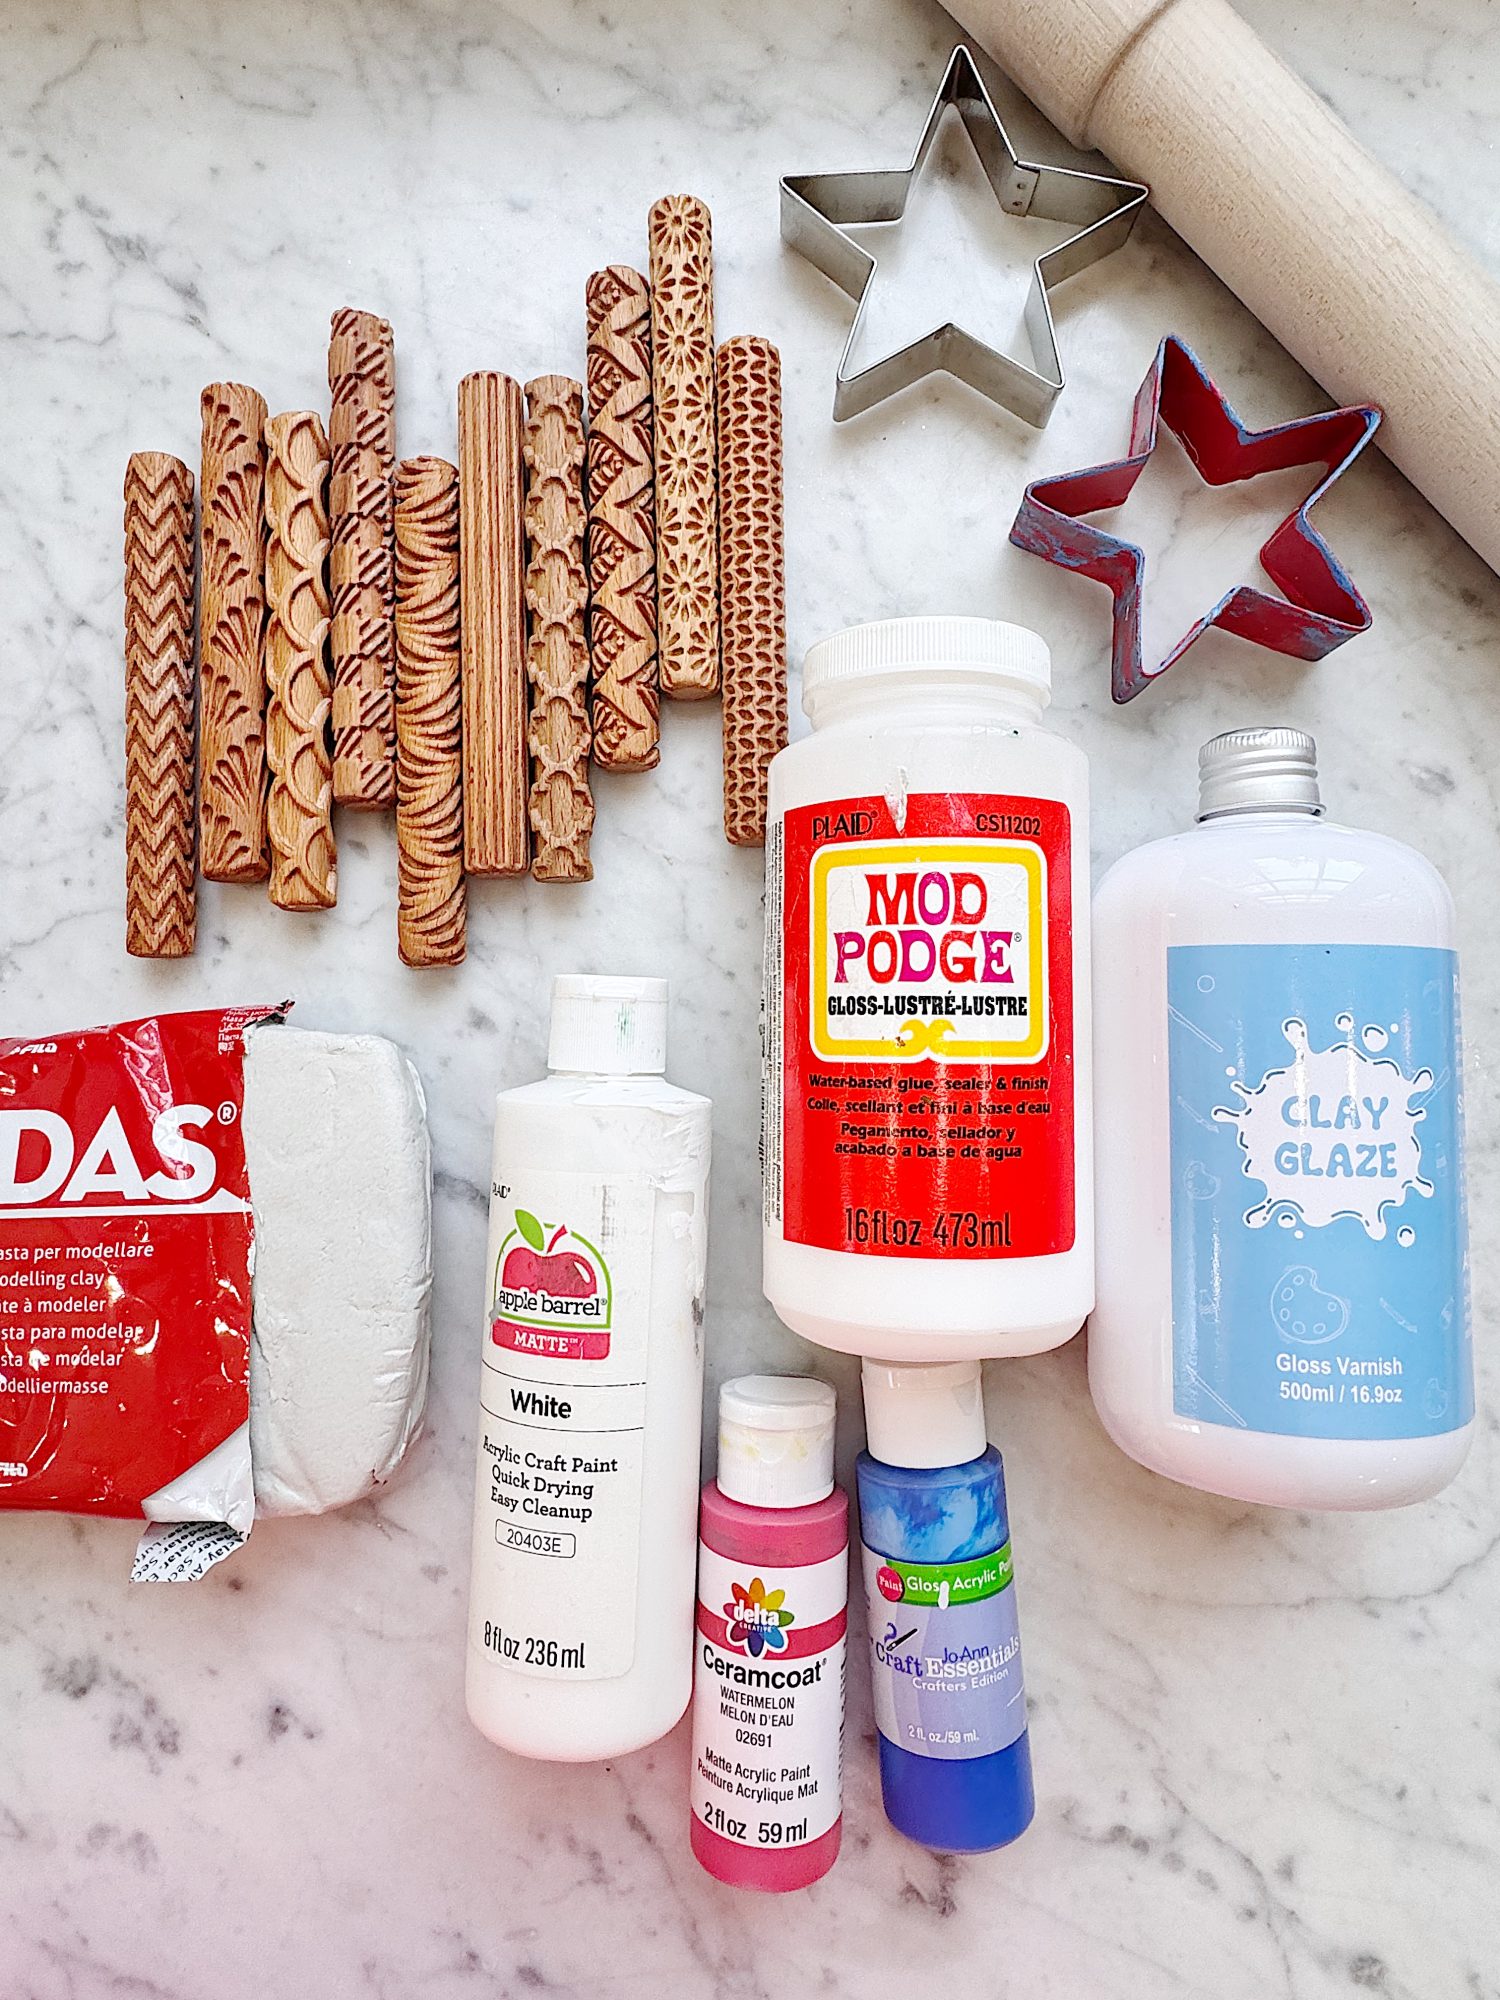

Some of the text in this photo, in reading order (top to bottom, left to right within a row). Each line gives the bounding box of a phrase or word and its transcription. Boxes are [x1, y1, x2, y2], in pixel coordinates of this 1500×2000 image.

[975, 813, 1041, 837] CS11202
[864, 871, 988, 927] MOD
[808, 1073, 893, 1089] Water-based
[897, 1076, 938, 1093] glue,
[996, 1076, 1007, 1091] &
[1011, 1076, 1049, 1091] finish
[806, 1097, 841, 1113] Colle,
[845, 1100, 903, 1114] scellant
[907, 1102, 926, 1115] et
[962, 1100, 973, 1115] à
[1016, 1100, 1051, 1115] d'eau
[1281, 1094, 1390, 1130] CLAY
[841, 1122, 934, 1141] Pegamento,
[1006, 1127, 1016, 1142] y
[834, 1142, 1023, 1162] acabado a base de agua
[1274, 1141, 1398, 1179] GLAZE
[33, 1246, 62, 1264] per
[65, 1241, 155, 1259] modellare
[70, 1269, 105, 1290] clay
[0, 1296, 107, 1314] te à modeler
[499, 1289, 538, 1312] apple
[30, 1326, 67, 1344] para
[71, 1321, 143, 1340] modelar
[29, 1350, 51, 1367] e
[55, 1349, 124, 1367] modelar
[1276, 1353, 1403, 1376] Gloss Varnish
[510, 1388, 572, 1419] White
[1279, 1381, 1403, 1404] 500ml / 16.9oz
[482, 1434, 619, 1473] Acrylic Craft Paint
[491, 1464, 595, 1500] Quick Drying
[490, 1485, 593, 1523] Easy Cleanup
[506, 1528, 562, 1553] 20403E
[878, 1575, 903, 1592] Paint
[906, 1576, 942, 1592] Glos
[952, 1568, 997, 1590] Acrylic
[733, 1598, 780, 1627] delta
[738, 1621, 773, 1633] CREATIVE
[875, 1634, 1020, 1679] Craft Essentials
[911, 1667, 1010, 1692] Crafters Edition
[720, 1684, 795, 1710] WATERMELON
[719, 1702, 794, 1727] MELON D'EAU
[735, 1728, 772, 1748] 02691
[705, 1746, 811, 1784] Matte Acrylic Paint
[697, 1757, 818, 1804] Peinture Acrylique Mat
